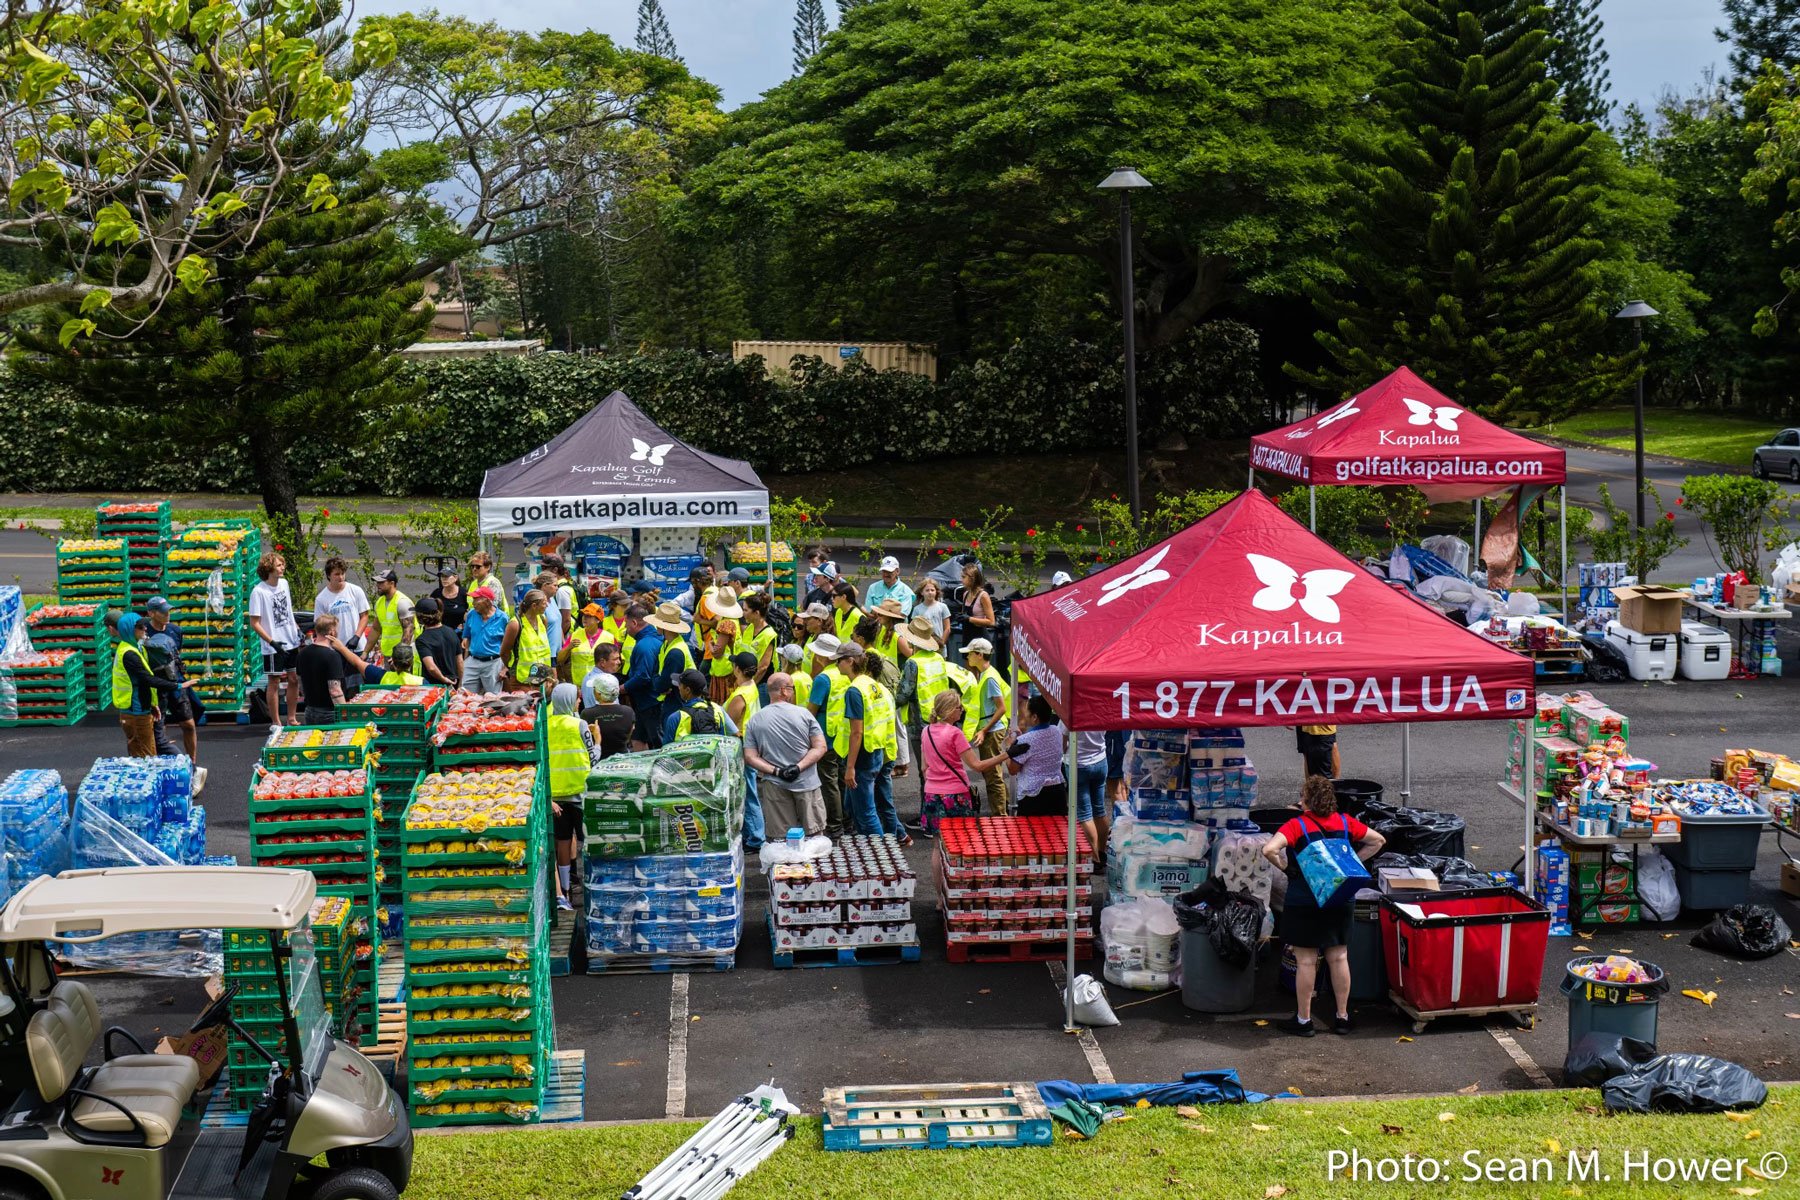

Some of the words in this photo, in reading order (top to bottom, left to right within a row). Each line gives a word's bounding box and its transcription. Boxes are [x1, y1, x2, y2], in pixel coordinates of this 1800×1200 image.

[1378, 429, 1461, 448] Kapalua
[570, 463, 628, 474] Kapalua
[632, 464, 663, 476] Golf
[613, 473, 629, 481] &
[633, 474, 677, 485] Tennis
[1335, 456, 1543, 480] golfatkapalua.com
[511, 498, 738, 526] golfatkapalua.com
[1197, 621, 1345, 650] Kapalua
[1112, 675, 1490, 720] 1-877-KAPALUA
[584, 730, 599, 769] adida
[1153, 871, 1191, 884] Towel
